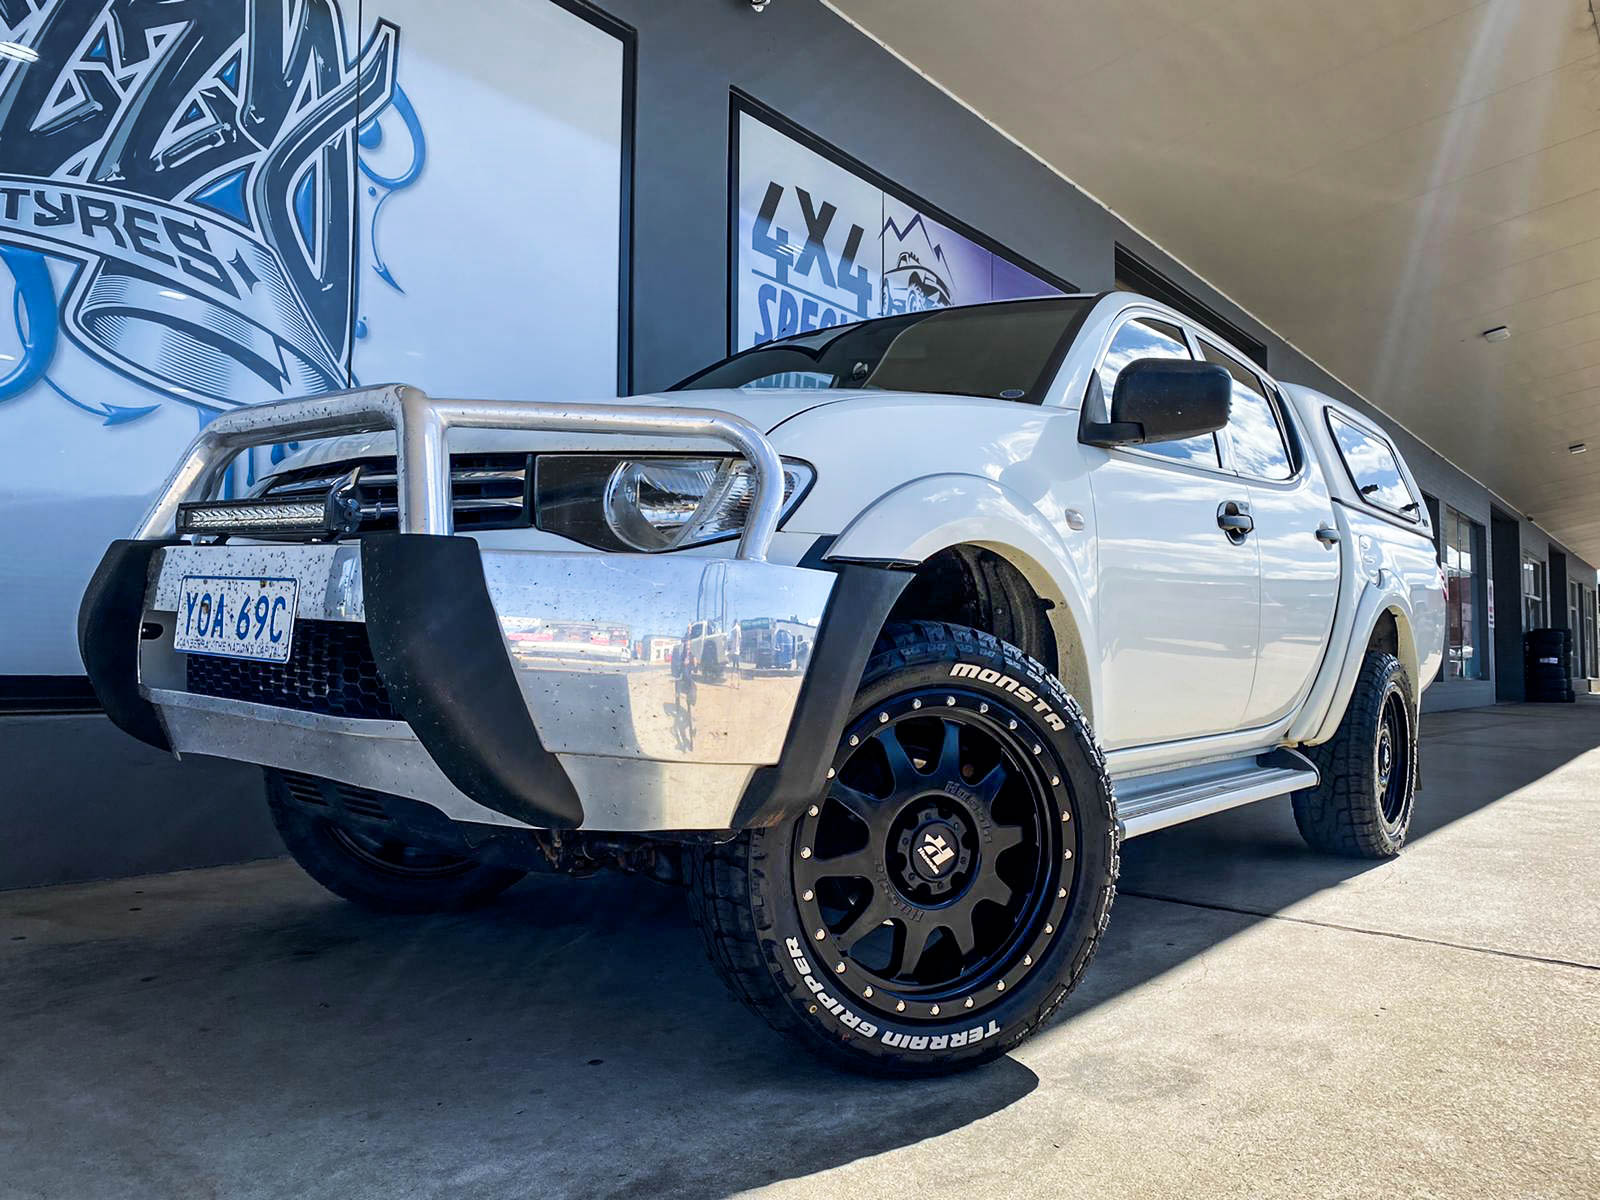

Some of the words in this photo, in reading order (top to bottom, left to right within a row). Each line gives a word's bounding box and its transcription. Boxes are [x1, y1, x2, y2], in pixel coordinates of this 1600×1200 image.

[0, 188, 241, 300] TYRES
[751, 181, 873, 318] 4X4
[754, 283, 848, 345] SPE
[185, 591, 225, 639] YOA
[235, 595, 287, 643] 69C
[949, 663, 1066, 732] MONSTA
[785, 936, 879, 1039] GRIPPER
[881, 1019, 1001, 1050] TERRAIN
